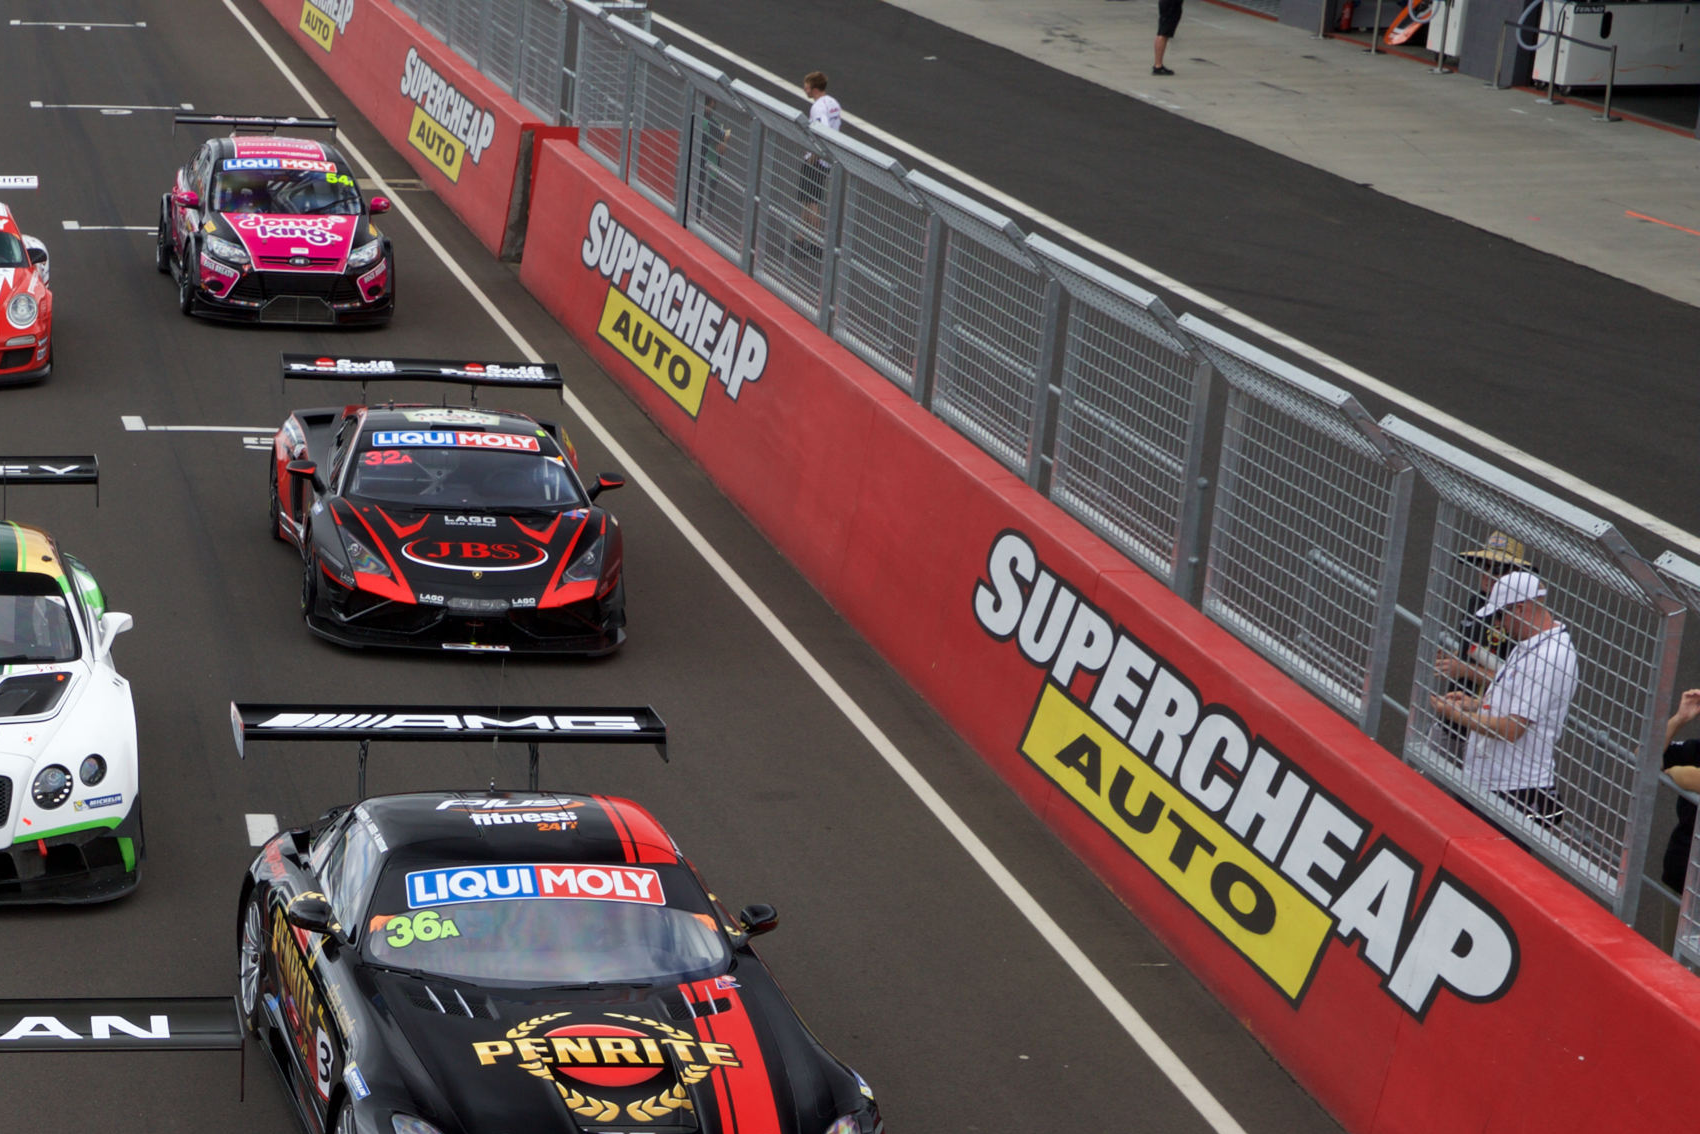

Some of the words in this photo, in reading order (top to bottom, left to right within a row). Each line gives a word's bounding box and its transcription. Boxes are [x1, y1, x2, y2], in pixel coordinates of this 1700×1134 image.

[304, 10, 330, 41] AUTO
[401, 46, 496, 165] SUPERCHEAP
[416, 120, 456, 167] AUTO
[227, 158, 279, 169] LIQUI
[281, 160, 333, 172] MOLY
[239, 214, 333, 230] donut
[257, 225, 333, 246] king
[582, 201, 768, 401] SUPERCHEAP
[612, 309, 692, 390] AUTO
[377, 432, 455, 445] LIQUI
[458, 434, 533, 449] MOLY
[365, 450, 413, 466] 32A
[444, 515, 497, 523] LAGO
[427, 541, 521, 561] JBS
[419, 593, 445, 602] LAGO
[512, 597, 536, 605] LAGO
[368, 714, 642, 731] AMG
[975, 533, 1513, 1013] SUPERCHEAP
[469, 811, 578, 826] fitness
[537, 821, 578, 831] 24/7
[1054, 733, 1277, 935] AUTO
[414, 868, 539, 904] LIQUI
[541, 868, 654, 900] MOLY
[386, 910, 460, 949] 36A
[318, 1041, 331, 1083] 3
[471, 1036, 742, 1068] PENRITE
